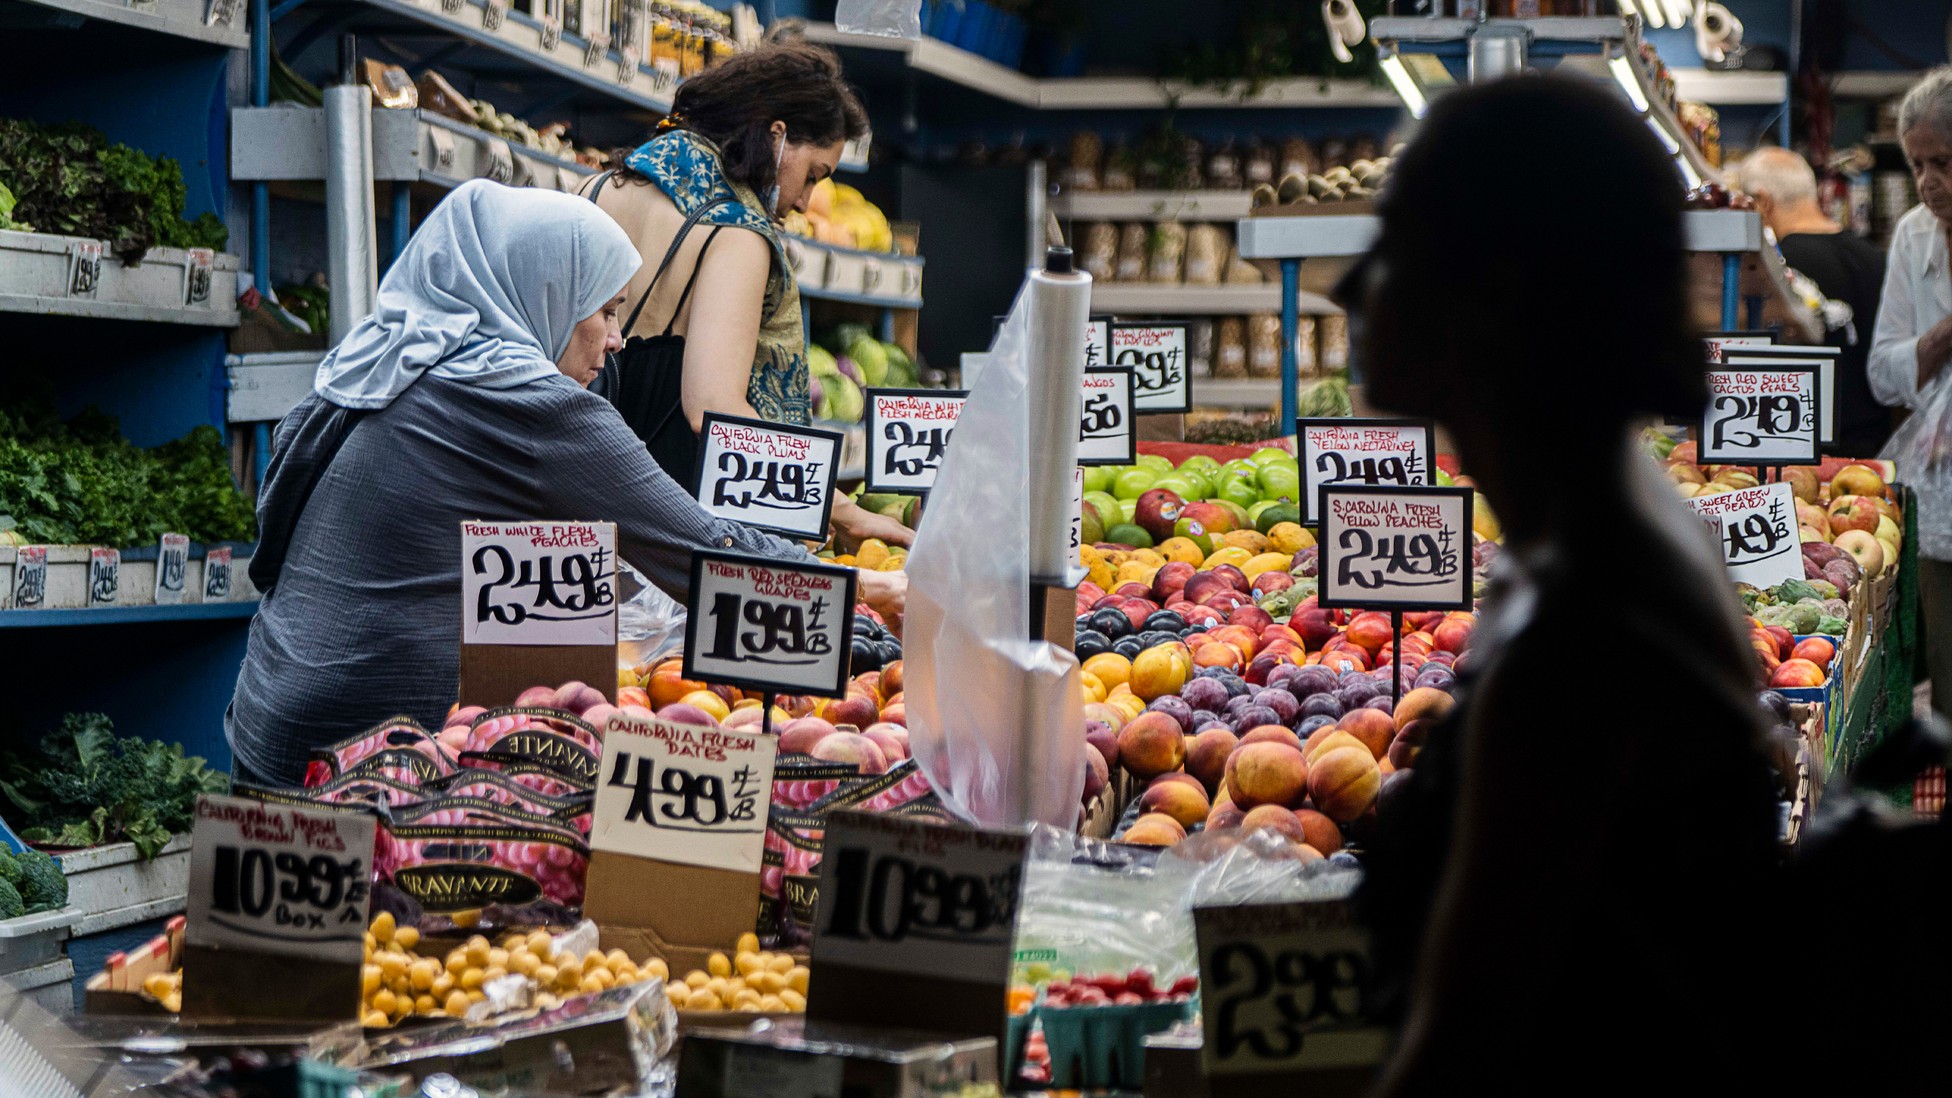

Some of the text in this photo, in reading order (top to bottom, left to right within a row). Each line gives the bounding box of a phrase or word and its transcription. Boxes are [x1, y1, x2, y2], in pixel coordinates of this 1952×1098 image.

[1713, 383, 1800, 394] CACTUS PEARS
[1735, 373, 1757, 384] RED
[1762, 372, 1806, 384] SWEET
[877, 396, 933, 411] CALIFORNIA
[880, 409, 912, 419] FLESH
[1081, 393, 1122, 435] 50
[1712, 395, 1800, 450] 249
[711, 424, 811, 450] CALIFORNIA FRESH
[1307, 427, 1399, 441] CALIFORNIA FRESH
[1313, 439, 1416, 451] YELLOW NECTARINES
[717, 436, 807, 460] BLACK PLUMS
[1316, 451, 1408, 485] 249
[713, 452, 806, 509] 249
[1332, 499, 1441, 516] S.CAROLINA FRESH
[1699, 494, 1732, 507] SWEET
[1735, 487, 1771, 503] GREEN
[1724, 498, 1767, 512] PEARS
[465, 524, 594, 537] FRESH WHITE FLESH
[1337, 513, 1444, 529] YELLOW PEACHES
[531, 535, 600, 547] PEACHES
[1338, 528, 1443, 589] 249
[472, 545, 597, 625] 249
[707, 562, 832, 590] FRESH RED SEEDLESS
[754, 583, 811, 601] GRAPES
[702, 592, 806, 662] 199
[608, 718, 756, 752] CALIFORNIA FRESH
[665, 741, 728, 762] DATES
[607, 751, 730, 826] 499
[210, 845, 345, 917] 1099
[402, 874, 514, 895] BRAVANTE
[821, 847, 993, 942] 1099
[1209, 940, 1366, 1060] 299
